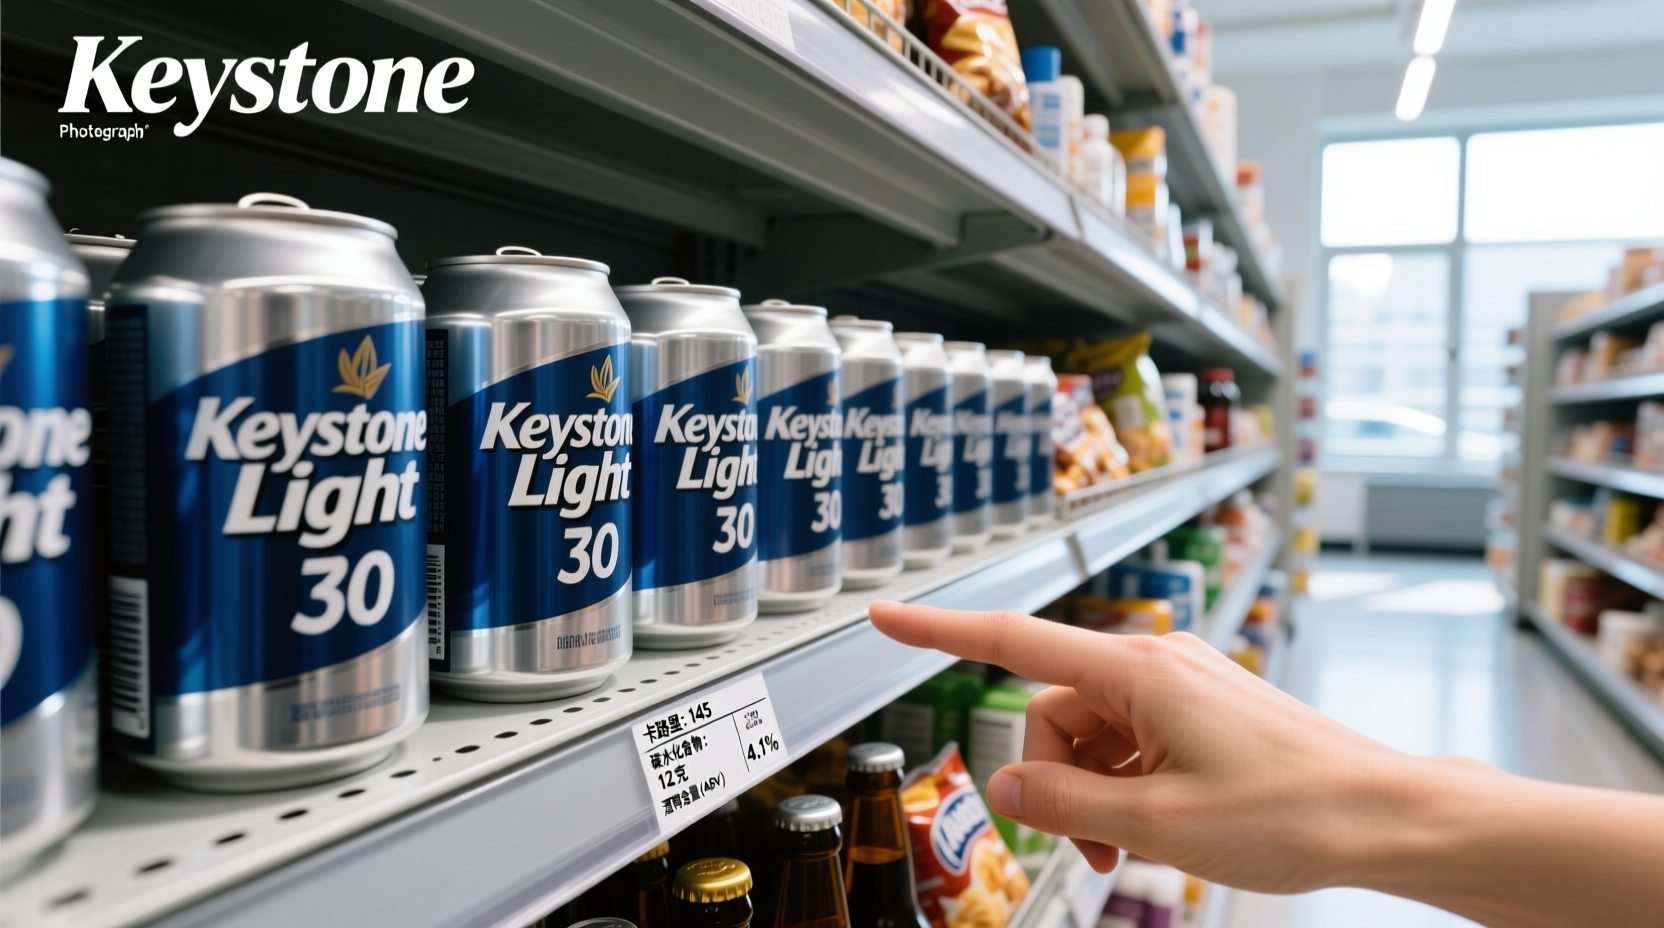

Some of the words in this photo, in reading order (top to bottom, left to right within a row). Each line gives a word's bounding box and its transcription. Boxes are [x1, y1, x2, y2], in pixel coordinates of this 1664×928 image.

[184, 396, 427, 473] Keystone
[479, 402, 633, 459] Keyston
[509, 451, 632, 519] Light
[783, 440, 842, 488] Ligh
[222, 457, 419, 549] Light
[713, 502, 754, 554] 30
[811, 489, 842, 533] 30
[557, 522, 619, 584] 30
[290, 550, 395, 635] 30
[688, 701, 712, 724] 145
[747, 732, 779, 761] 4.1%
